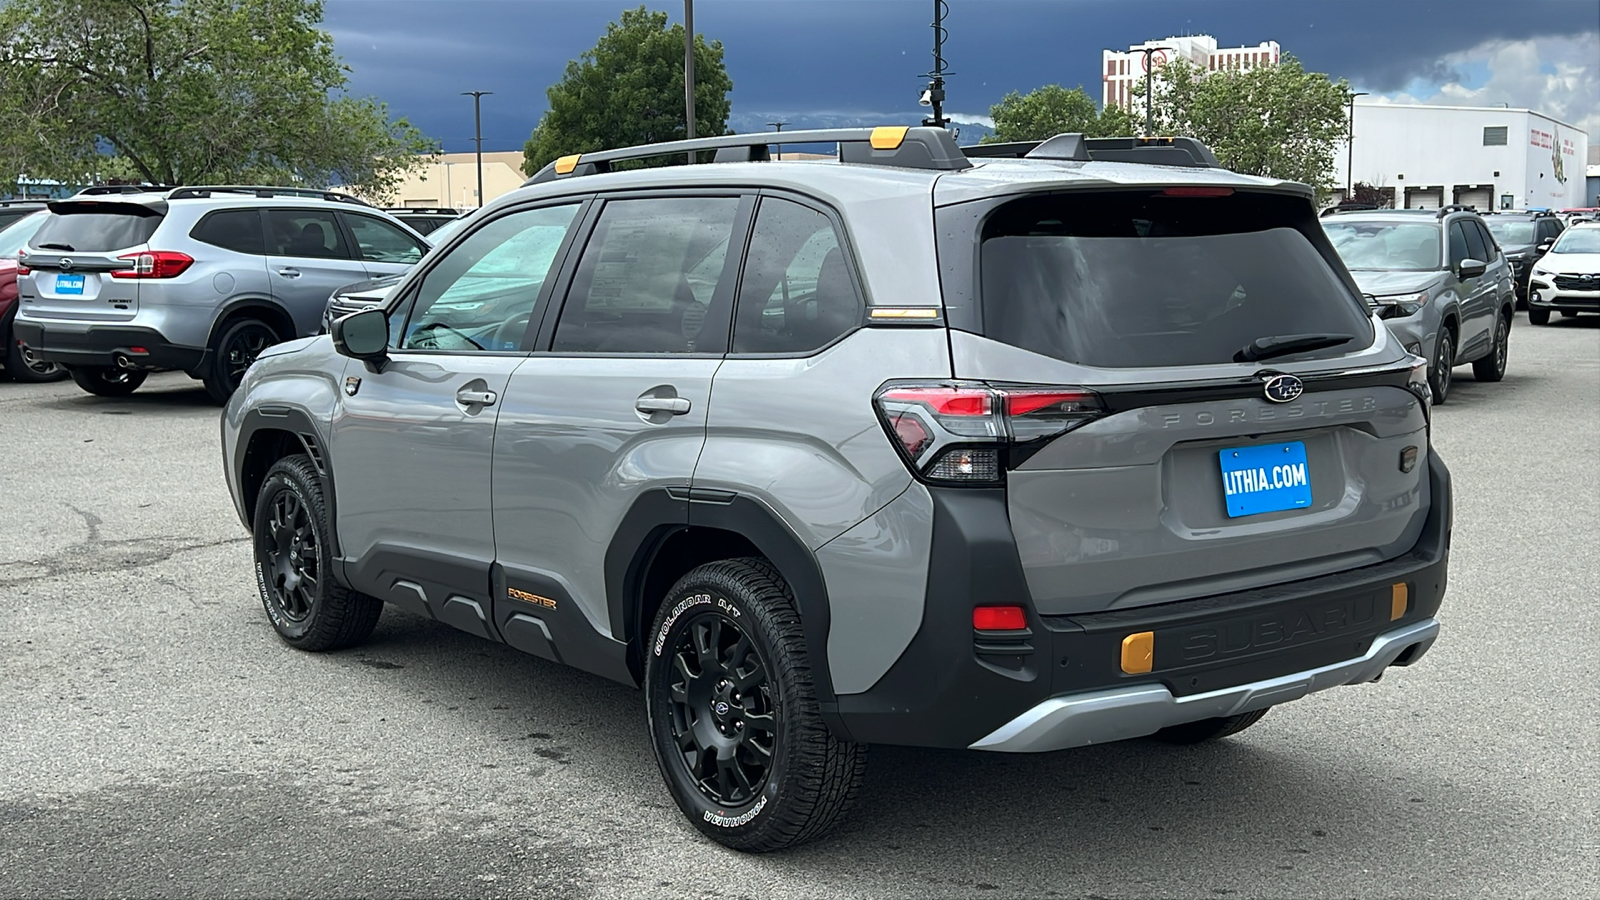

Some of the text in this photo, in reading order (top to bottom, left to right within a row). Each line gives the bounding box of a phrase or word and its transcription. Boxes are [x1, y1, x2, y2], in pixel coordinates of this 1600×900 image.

[1162, 397, 1377, 429] FORESTER
[1223, 463, 1307, 496] LITHIA.COM
[507, 587, 557, 610] FORESTER
[654, 593, 741, 657] GEOLANDAR A/T
[1182, 595, 1375, 661] SUBARU
[703, 795, 768, 828] YOKOHAMA
